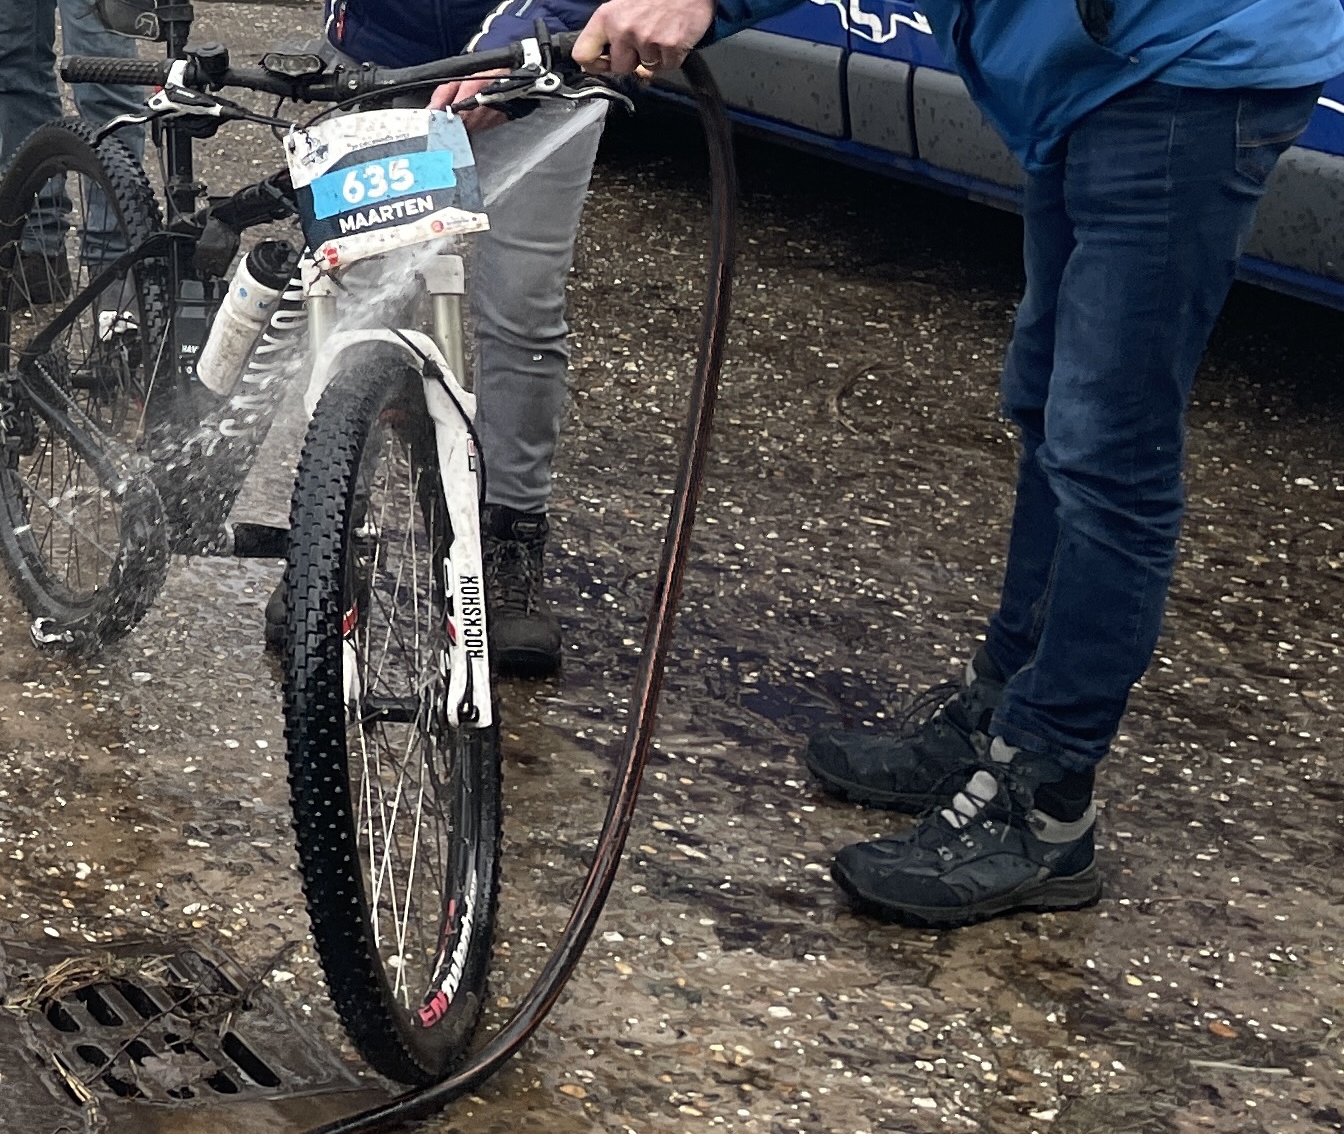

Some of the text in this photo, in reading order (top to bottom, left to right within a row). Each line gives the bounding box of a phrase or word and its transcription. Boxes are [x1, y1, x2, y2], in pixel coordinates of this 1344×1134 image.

[342, 159, 414, 204] 635
[338, 195, 434, 233] MAARTEN
[459, 574, 484, 659] ROCKSHOX
